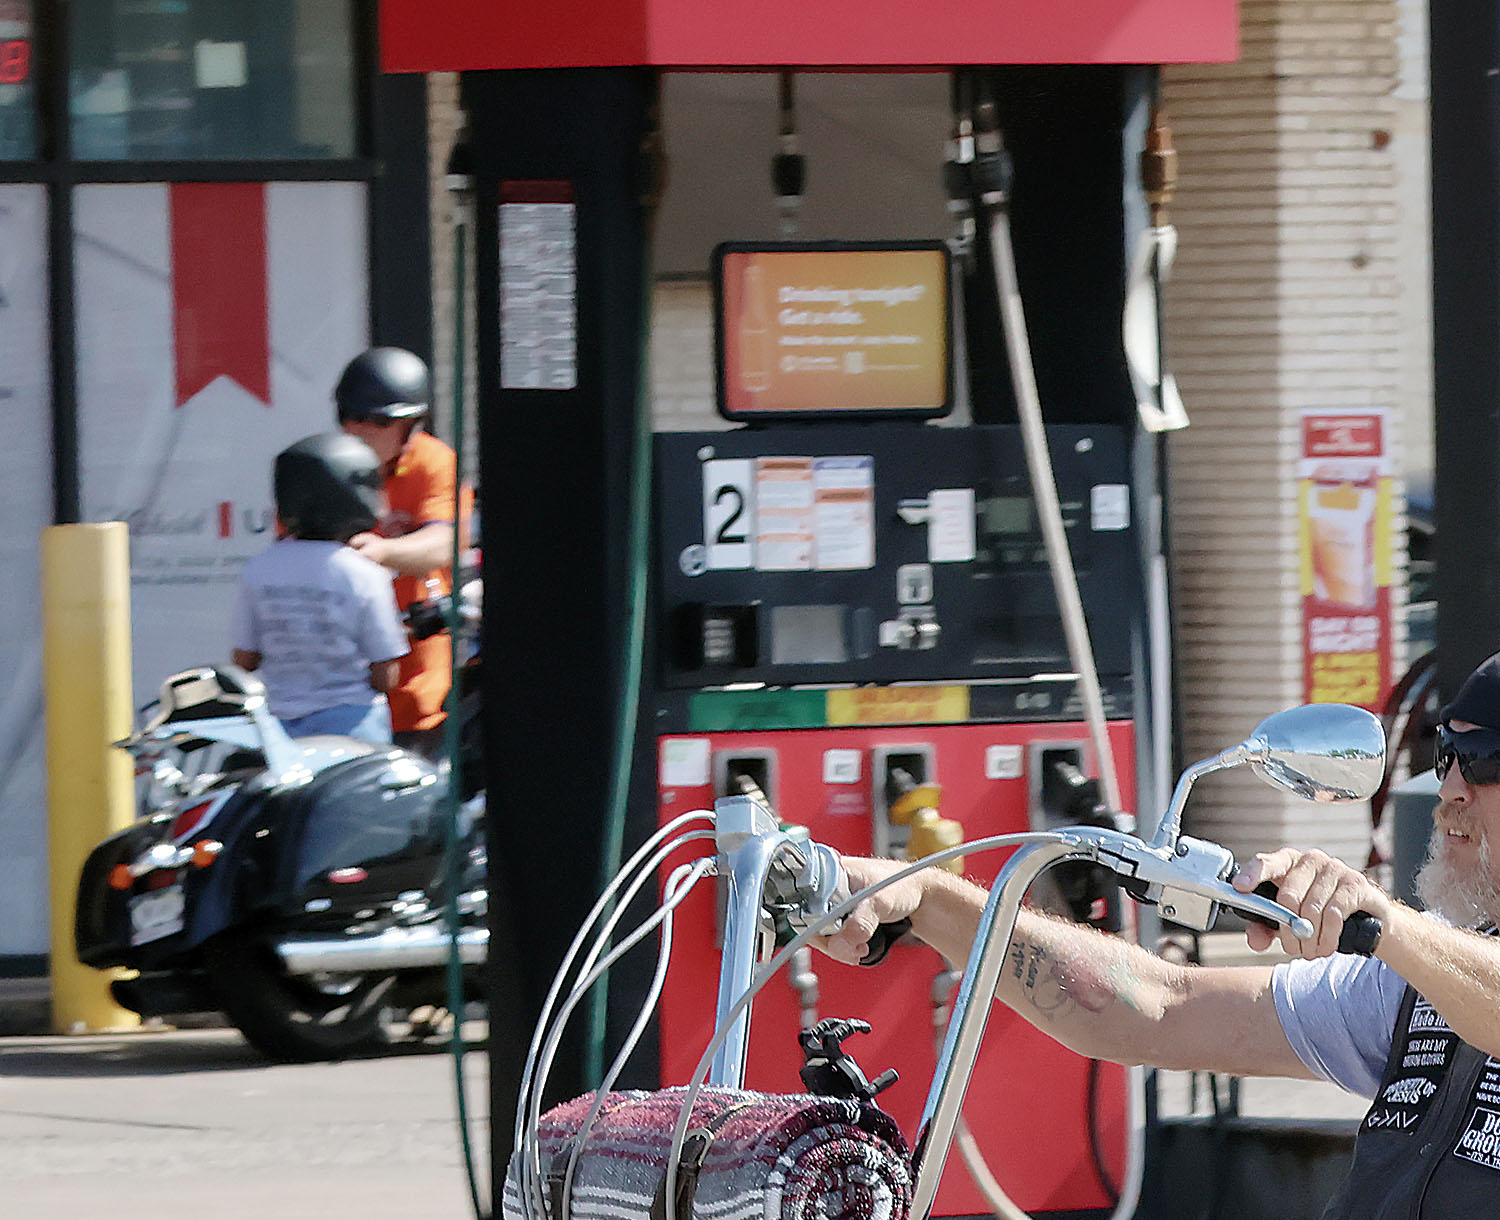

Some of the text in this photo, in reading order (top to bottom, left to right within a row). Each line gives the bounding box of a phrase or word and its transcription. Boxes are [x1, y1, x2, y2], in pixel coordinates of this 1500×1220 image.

[713, 483, 746, 544] 2
[1486, 1072, 1499, 1082] THE
[1422, 1081, 1437, 1098] OF
[1480, 1082, 1488, 1090] BE
[1476, 1092, 1493, 1102] HAVE
